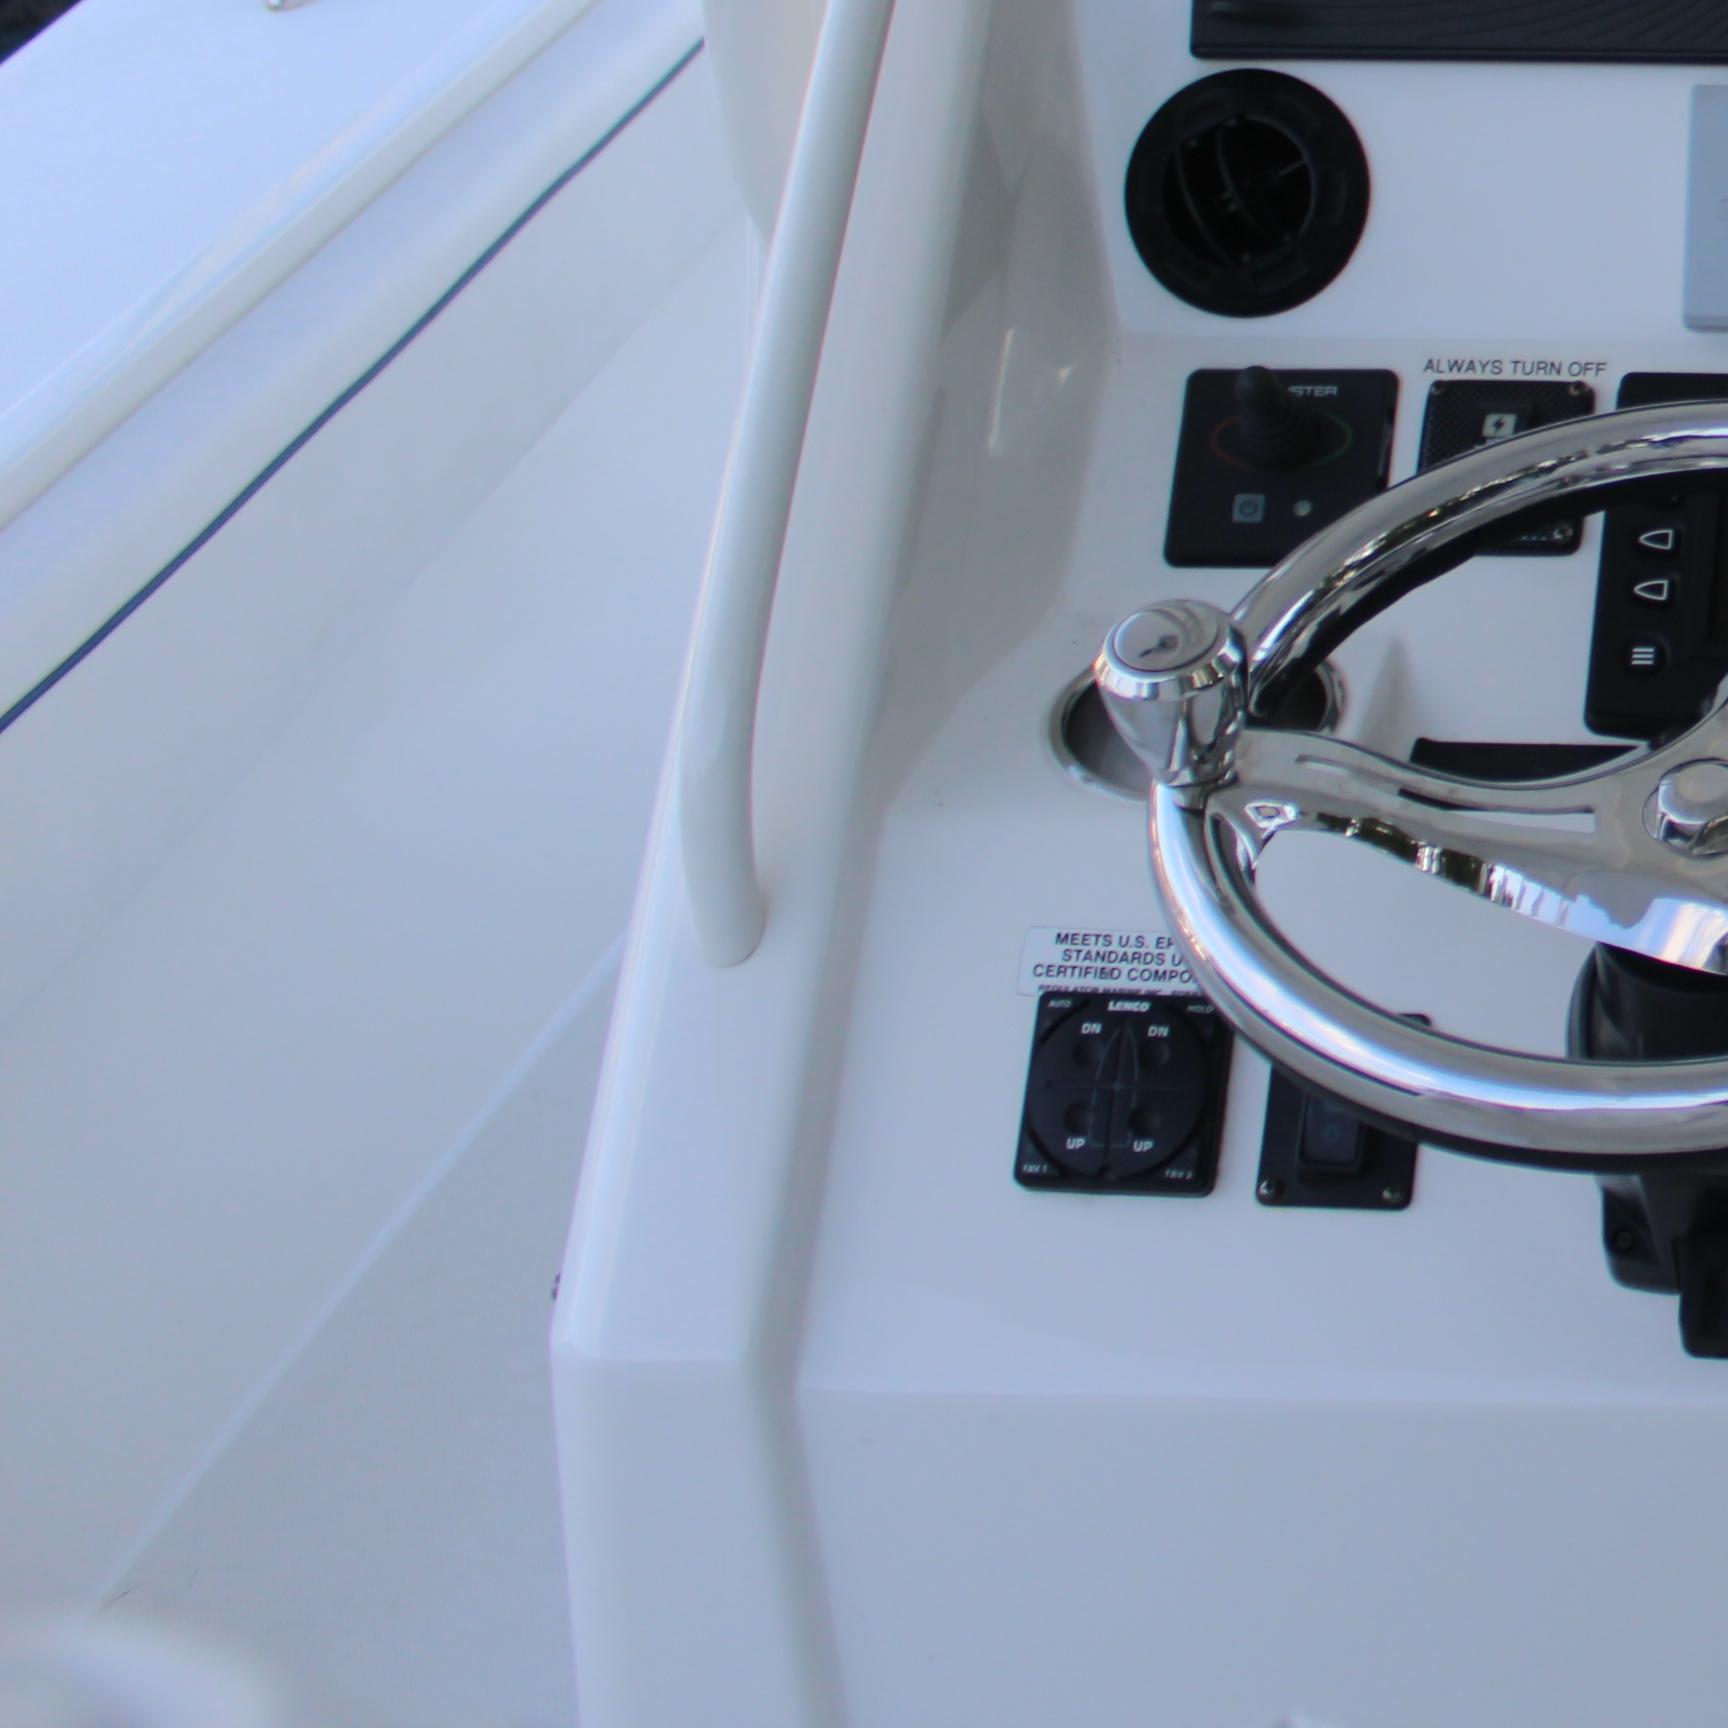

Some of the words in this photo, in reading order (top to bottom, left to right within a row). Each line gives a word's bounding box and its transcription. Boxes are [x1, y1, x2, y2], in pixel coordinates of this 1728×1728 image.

[1423, 358, 1503, 374] ALWAYS
[1510, 360, 1562, 376] TURN
[1568, 361, 1607, 377] OFF
[1055, 932, 1112, 948] MEETS
[1118, 934, 1149, 949] U.S.
[1061, 948, 1166, 967] STANDARDS
[1032, 963, 1121, 981] CERTIFIED
[1127, 967, 1192, 984] COMPO
[1048, 999, 1072, 1009] AUTO
[1107, 1000, 1150, 1012] LENCO
[1186, 1004, 1214, 1014] HOLD
[1081, 1023, 1102, 1034] DN
[1147, 1026, 1169, 1037] DN
[1066, 1138, 1085, 1149] UP
[1133, 1140, 1154, 1152] UP
[1023, 1164, 1042, 1173] FAV
[1165, 1168, 1183, 1178] FAV
